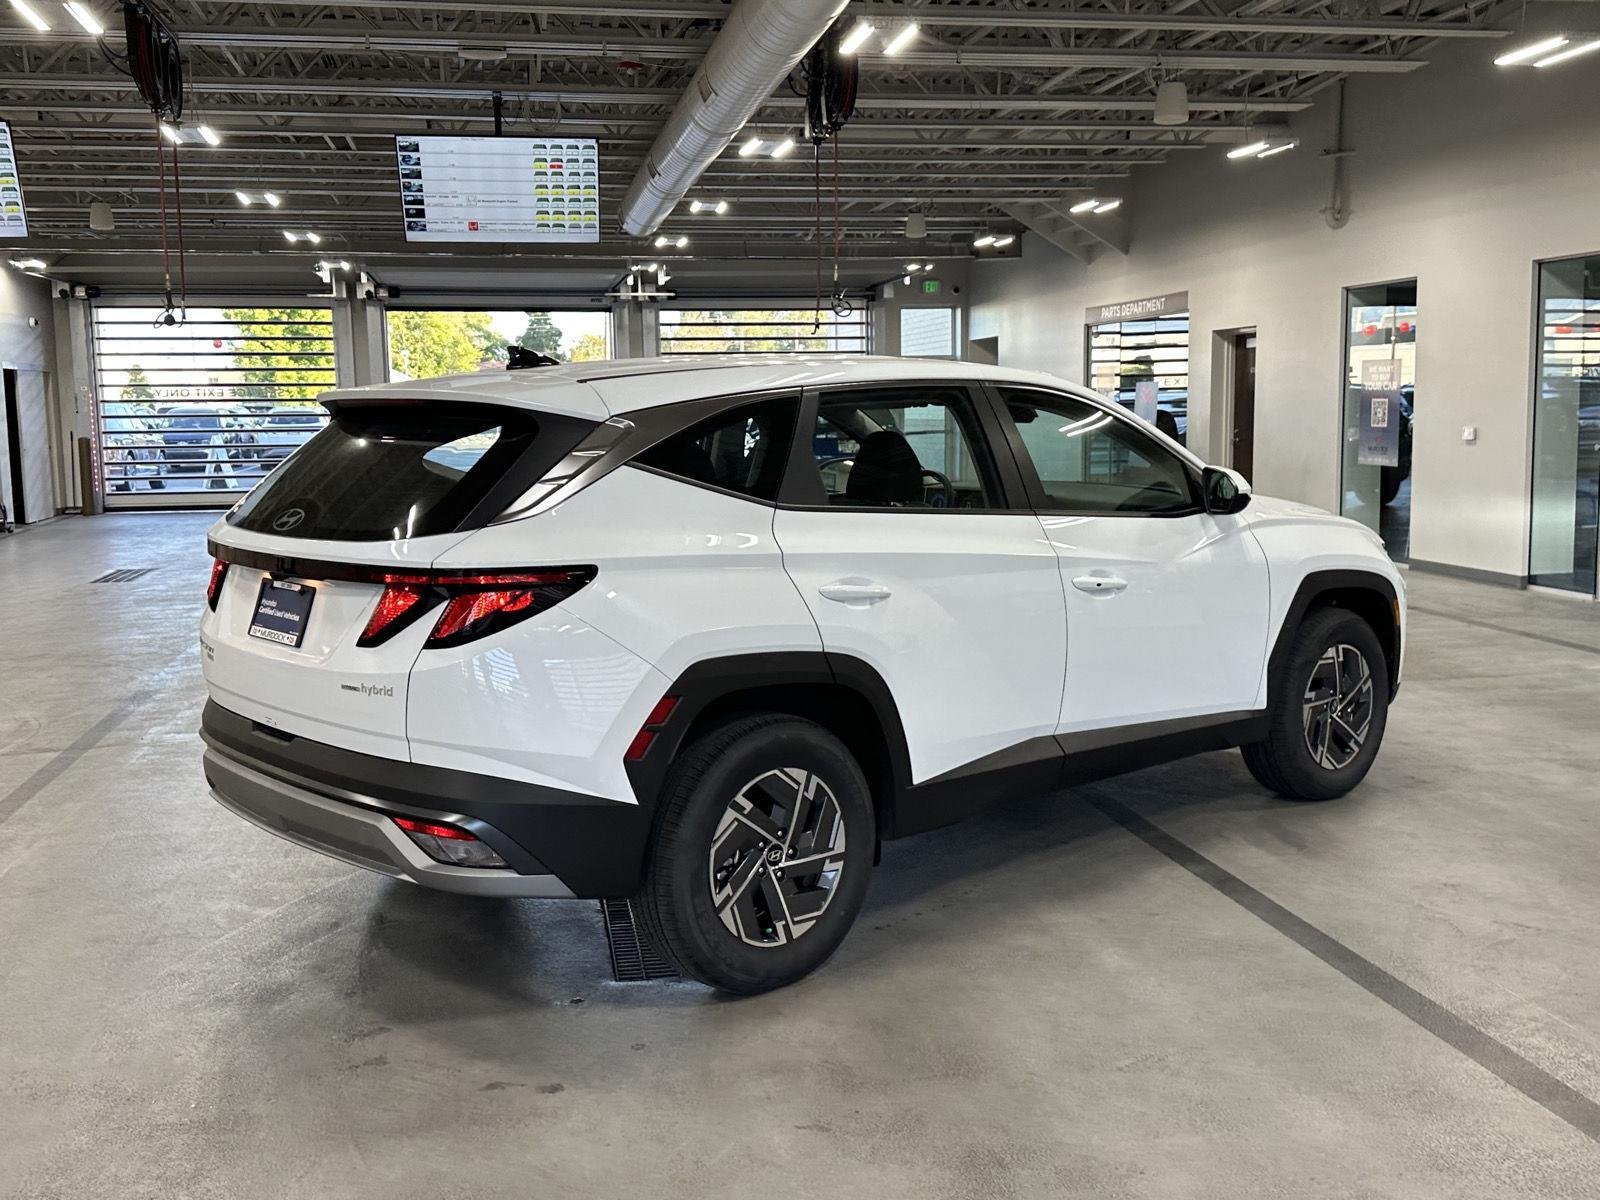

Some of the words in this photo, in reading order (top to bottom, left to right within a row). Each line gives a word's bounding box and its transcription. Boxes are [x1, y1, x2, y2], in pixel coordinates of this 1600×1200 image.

[1101, 305, 1121, 318] PARTS
[1121, 297, 1166, 316] DEPARTMENT
[1383, 381, 1398, 391] CAR
[274, 609, 284, 618] Used
[284, 612, 300, 621] Vehicles
[261, 630, 286, 641] MURDOCK
[361, 683, 393, 696] hybrid
